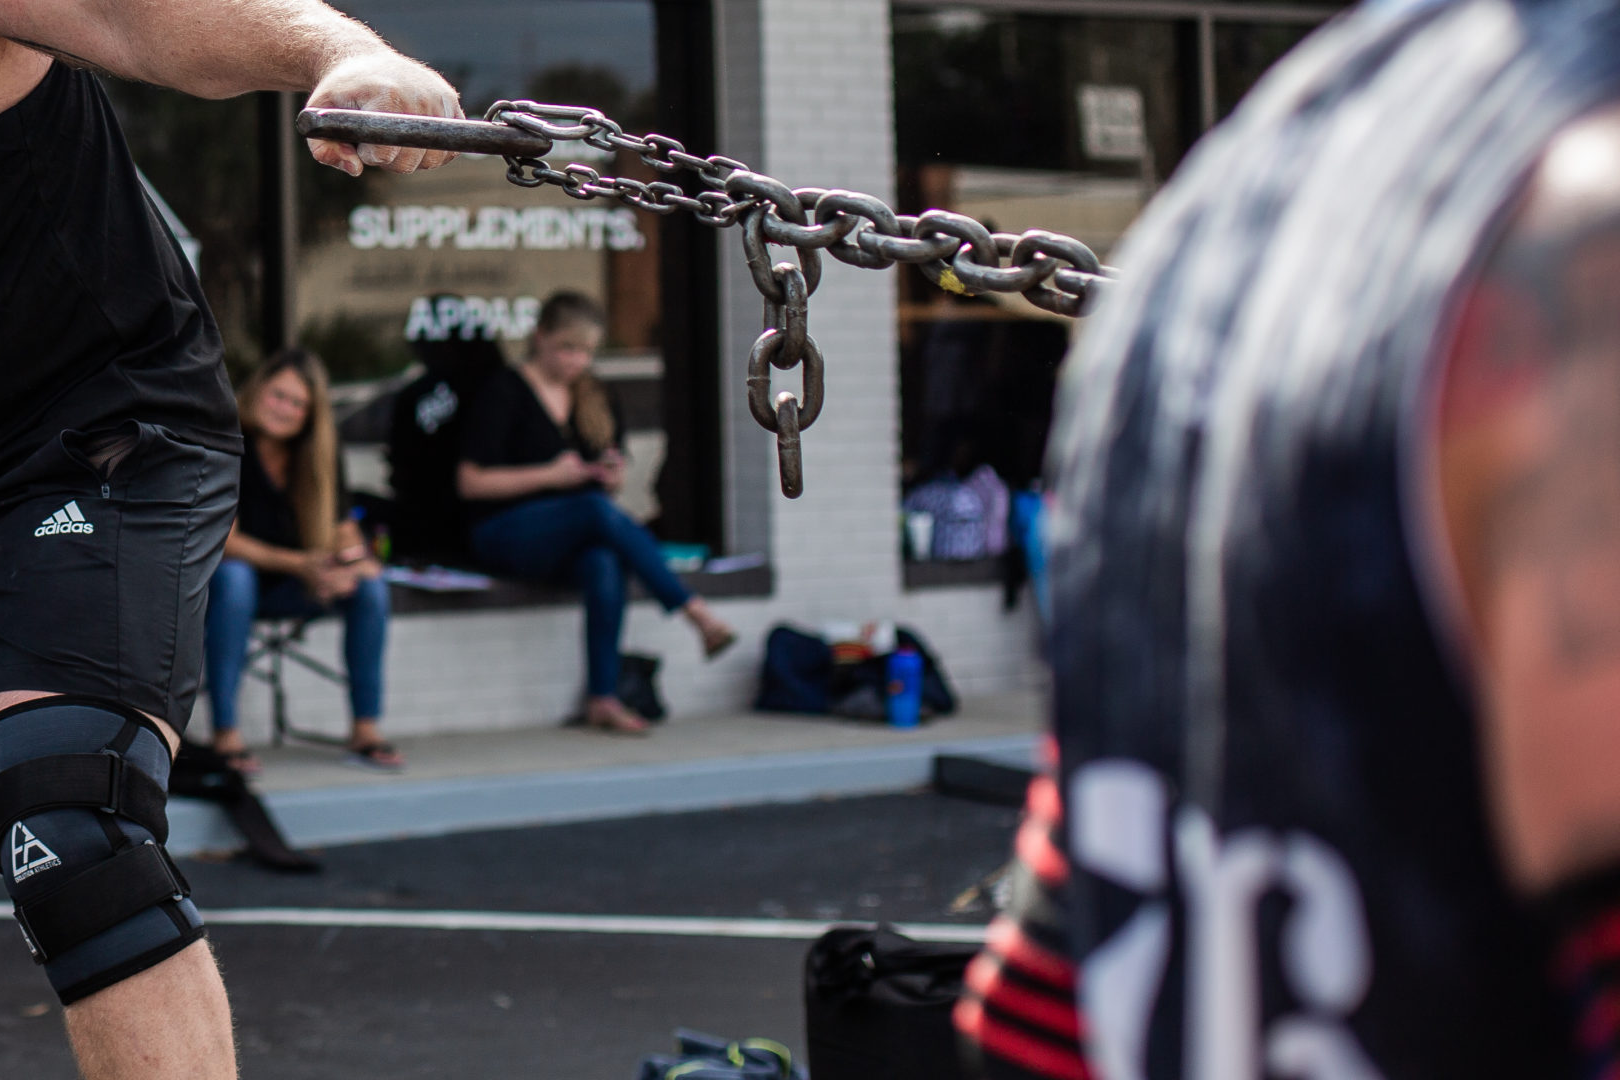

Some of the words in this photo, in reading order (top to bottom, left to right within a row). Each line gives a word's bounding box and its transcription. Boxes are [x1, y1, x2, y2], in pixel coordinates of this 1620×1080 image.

[349, 205, 645, 251] SUPPLEMENTS.
[404, 295, 541, 341] APPAR
[34, 521, 94, 537] adidas
